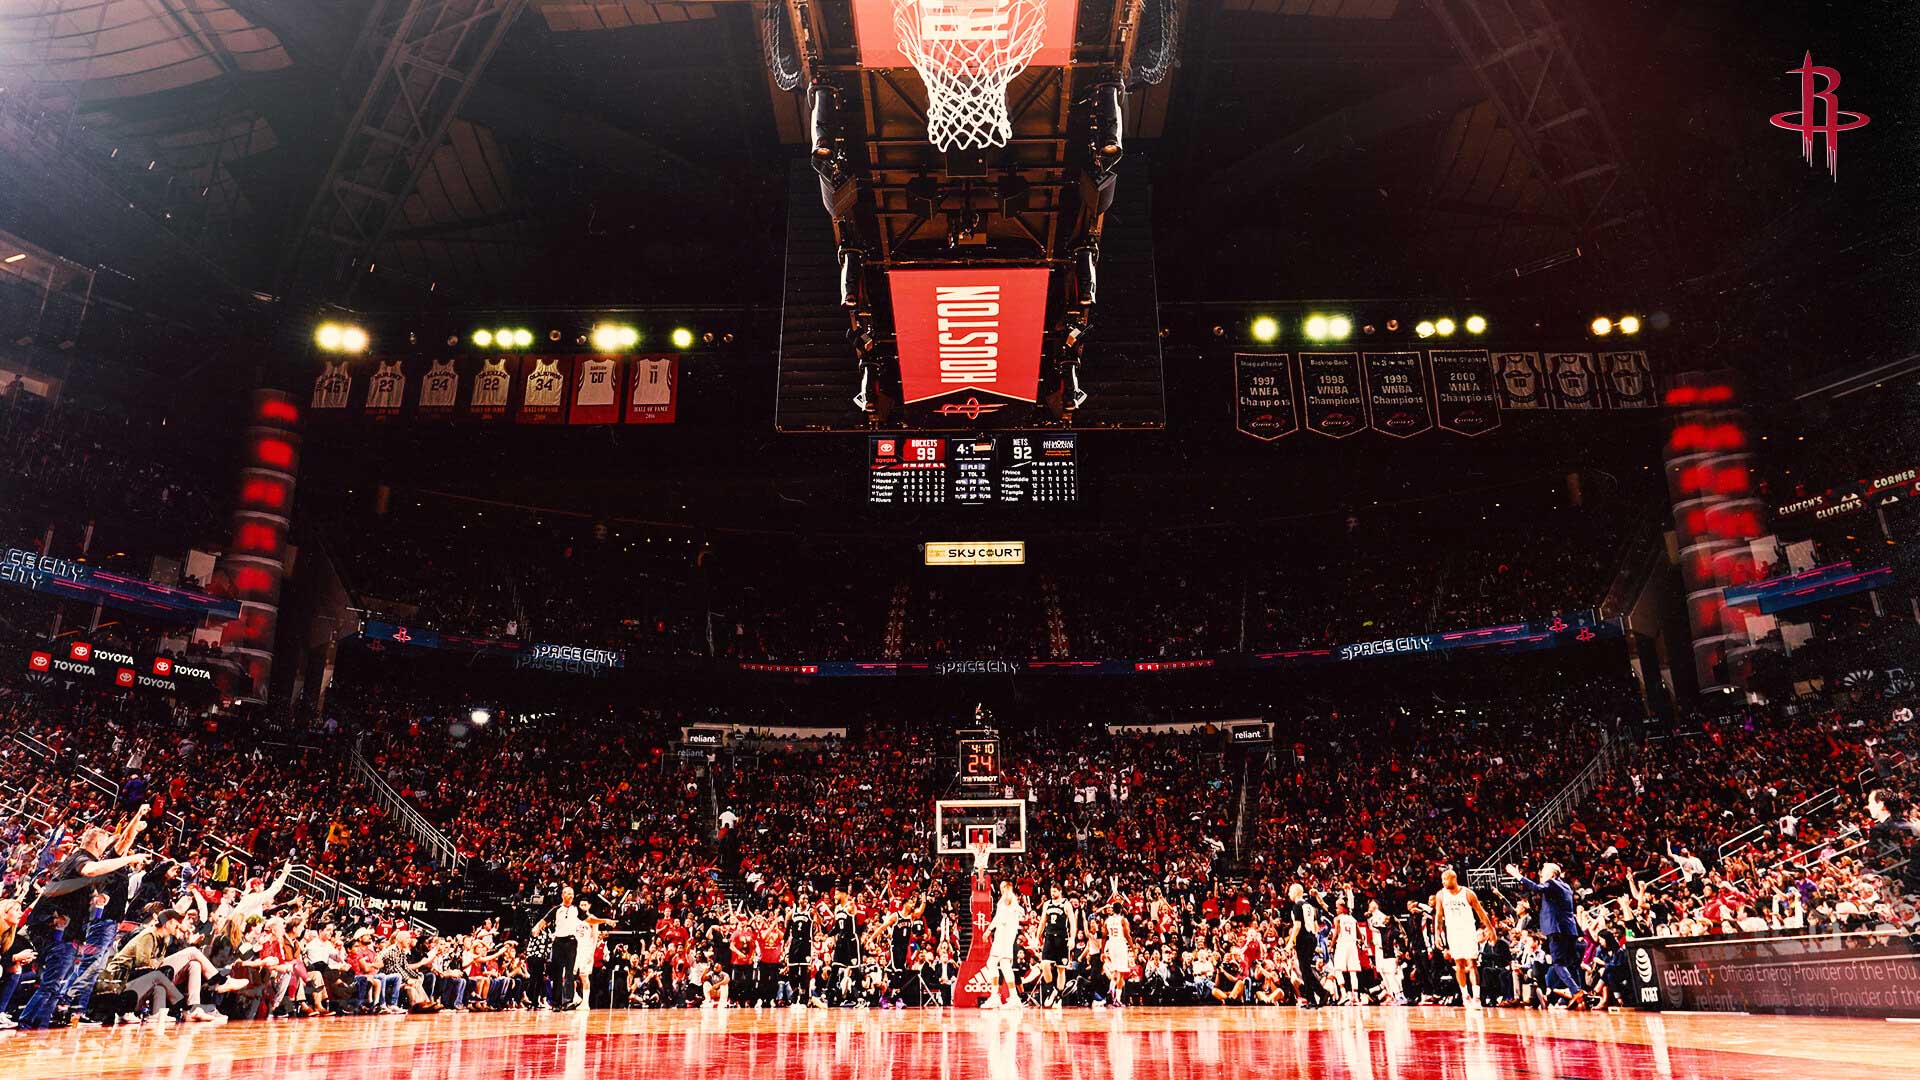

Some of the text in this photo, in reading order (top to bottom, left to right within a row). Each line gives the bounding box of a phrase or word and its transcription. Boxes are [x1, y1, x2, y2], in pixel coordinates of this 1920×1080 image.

[936, 285, 1000, 383] HOUSTON
[649, 371, 659, 384] 11
[1320, 375, 1345, 384] 1998
[1383, 374, 1408, 384] 1999
[1450, 372, 1476, 381] 2000
[379, 379, 394, 392] 23
[431, 378, 449, 391] 24
[483, 378, 500, 391] 22
[536, 378, 554, 391] 34
[1317, 385, 1349, 395] WNBA
[1381, 385, 1413, 394] WNBA
[1309, 396, 1361, 407] Champions
[911, 439, 938, 447] ROCKETS
[917, 448, 936, 460] 99
[1013, 447, 1032, 459] 92
[1873, 469, 1916, 489] CORNER
[1779, 495, 1823, 516] CLUTCH'S
[1815, 498, 1863, 520] CLUTCH'S
[948, 548, 976, 558] SKY
[978, 548, 1022, 558] COURT
[38, 555, 84, 583] CITY
[1340, 636, 1433, 661] SPACE CITY
[94, 649, 134, 665] TOYOTA
[583, 648, 618, 668] CITY
[54, 659, 96, 676] TOYOTA
[174, 664, 211, 680] TOYOTA
[138, 675, 176, 691] TOYOTA
[690, 734, 716, 743] reliant
[1235, 730, 1261, 739] reliant
[971, 743, 995, 754] 4:10
[968, 754, 992, 773] 24
[1664, 960, 1920, 986] reliant Official Energy Provider of the Hou
[1641, 986, 1658, 1002] AT&T
[1830, 986, 1880, 1007] Provider
[1884, 985, 1898, 1006] of
